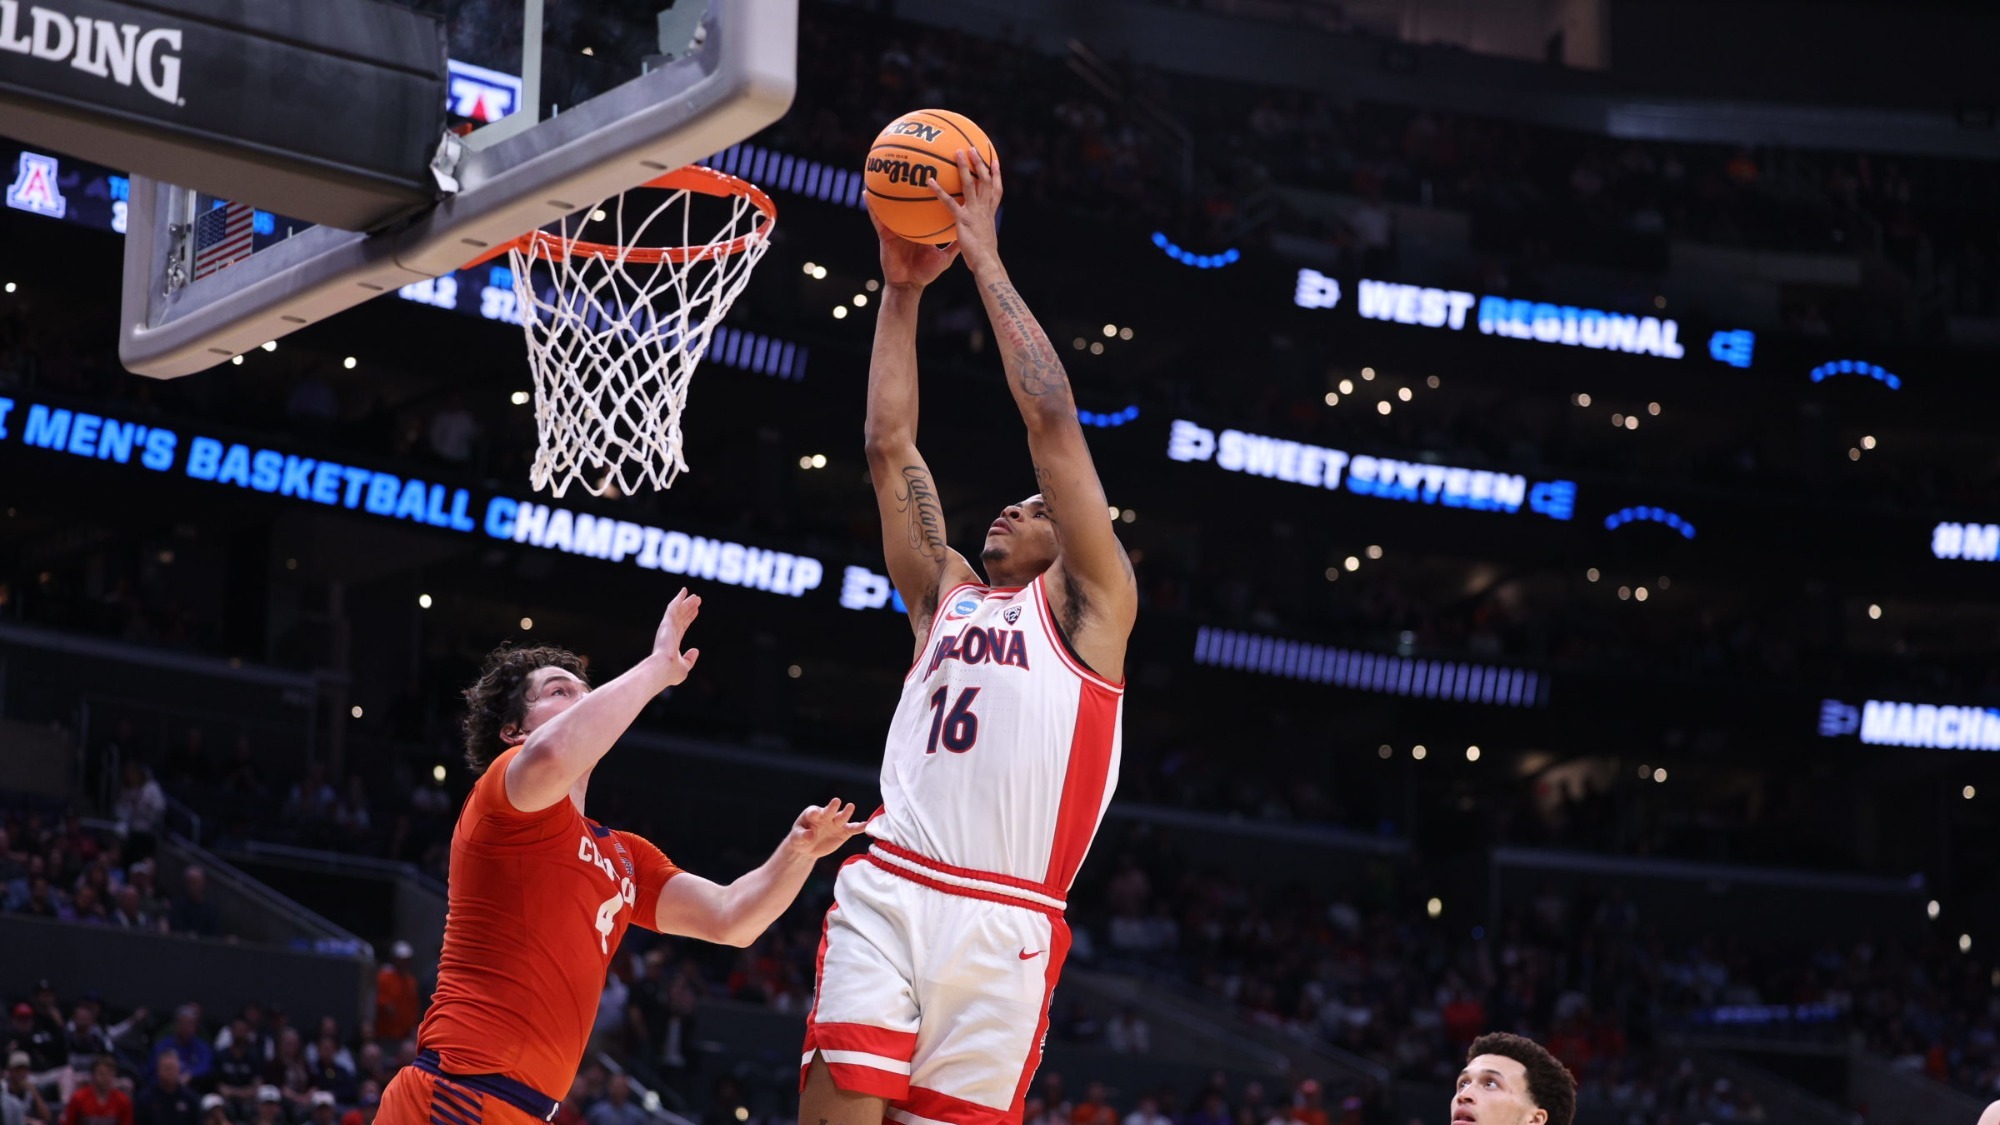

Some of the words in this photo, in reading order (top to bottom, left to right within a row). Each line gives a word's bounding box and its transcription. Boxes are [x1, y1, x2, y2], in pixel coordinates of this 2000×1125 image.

[867, 157, 938, 187] Wilson
[1358, 279, 1475, 330] WEST
[1478, 296, 1684, 359] REGIONAL
[23, 404, 178, 471] MEN'S
[186, 436, 475, 532] BASKETBALL
[484, 497, 823, 597] CHAMPIONSHIP
[1216, 429, 1349, 489] SWEET
[1346, 455, 1526, 513] SIXTEEN
[1931, 522, 2000, 561] #M
[926, 685, 981, 754] 16
[595, 891, 624, 955] 4
